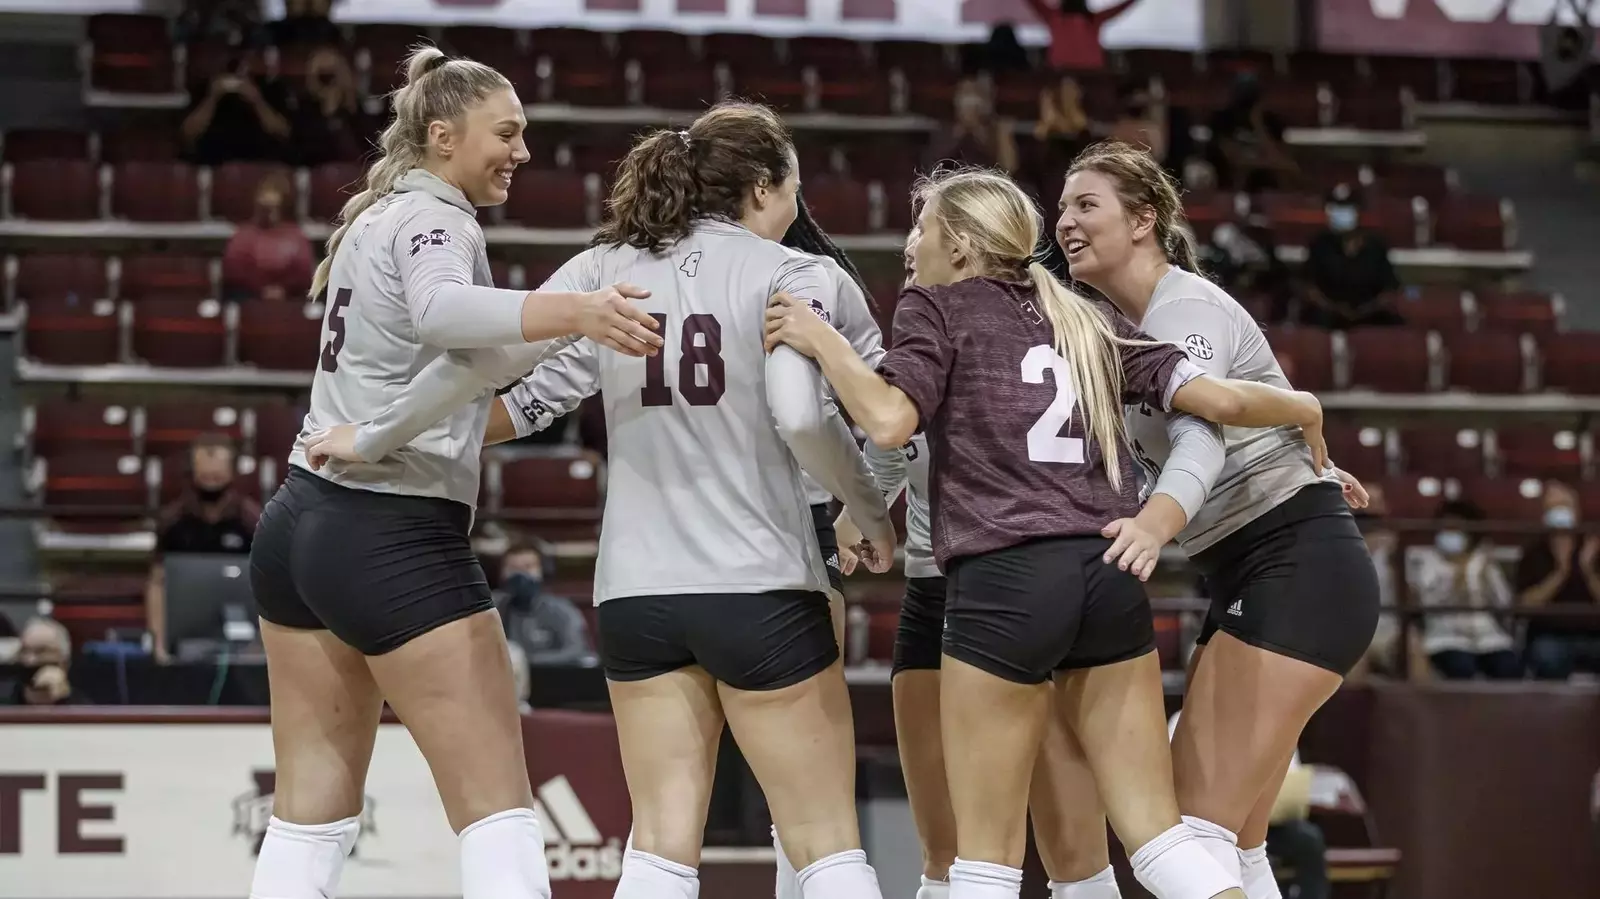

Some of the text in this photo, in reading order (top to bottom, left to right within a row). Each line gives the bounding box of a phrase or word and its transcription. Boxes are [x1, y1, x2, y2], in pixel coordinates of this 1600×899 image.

[321, 287, 352, 373] 5
[641, 313, 725, 406] 18
[1020, 344, 1084, 463] 2
